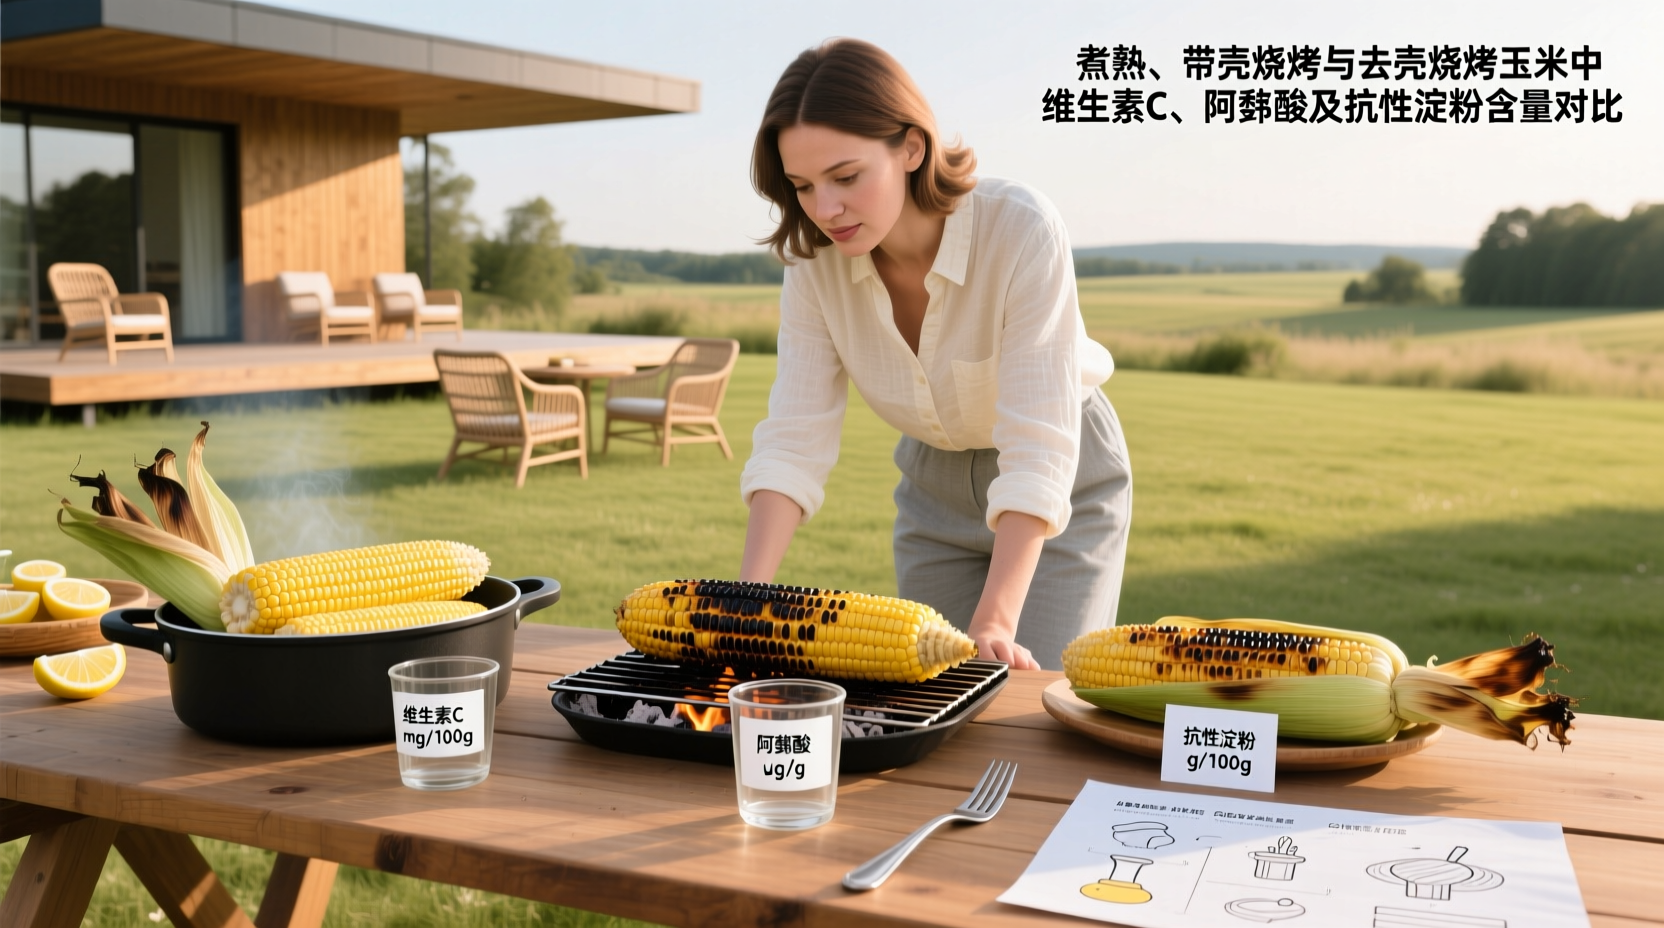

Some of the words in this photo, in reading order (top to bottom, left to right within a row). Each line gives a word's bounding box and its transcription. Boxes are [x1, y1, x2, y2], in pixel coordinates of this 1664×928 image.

[402, 704, 464, 725] 维生素C
[403, 728, 473, 749] mg/100g
[1183, 726, 1256, 751] 抗性淀粉
[1186, 752, 1252, 777] g/100g
